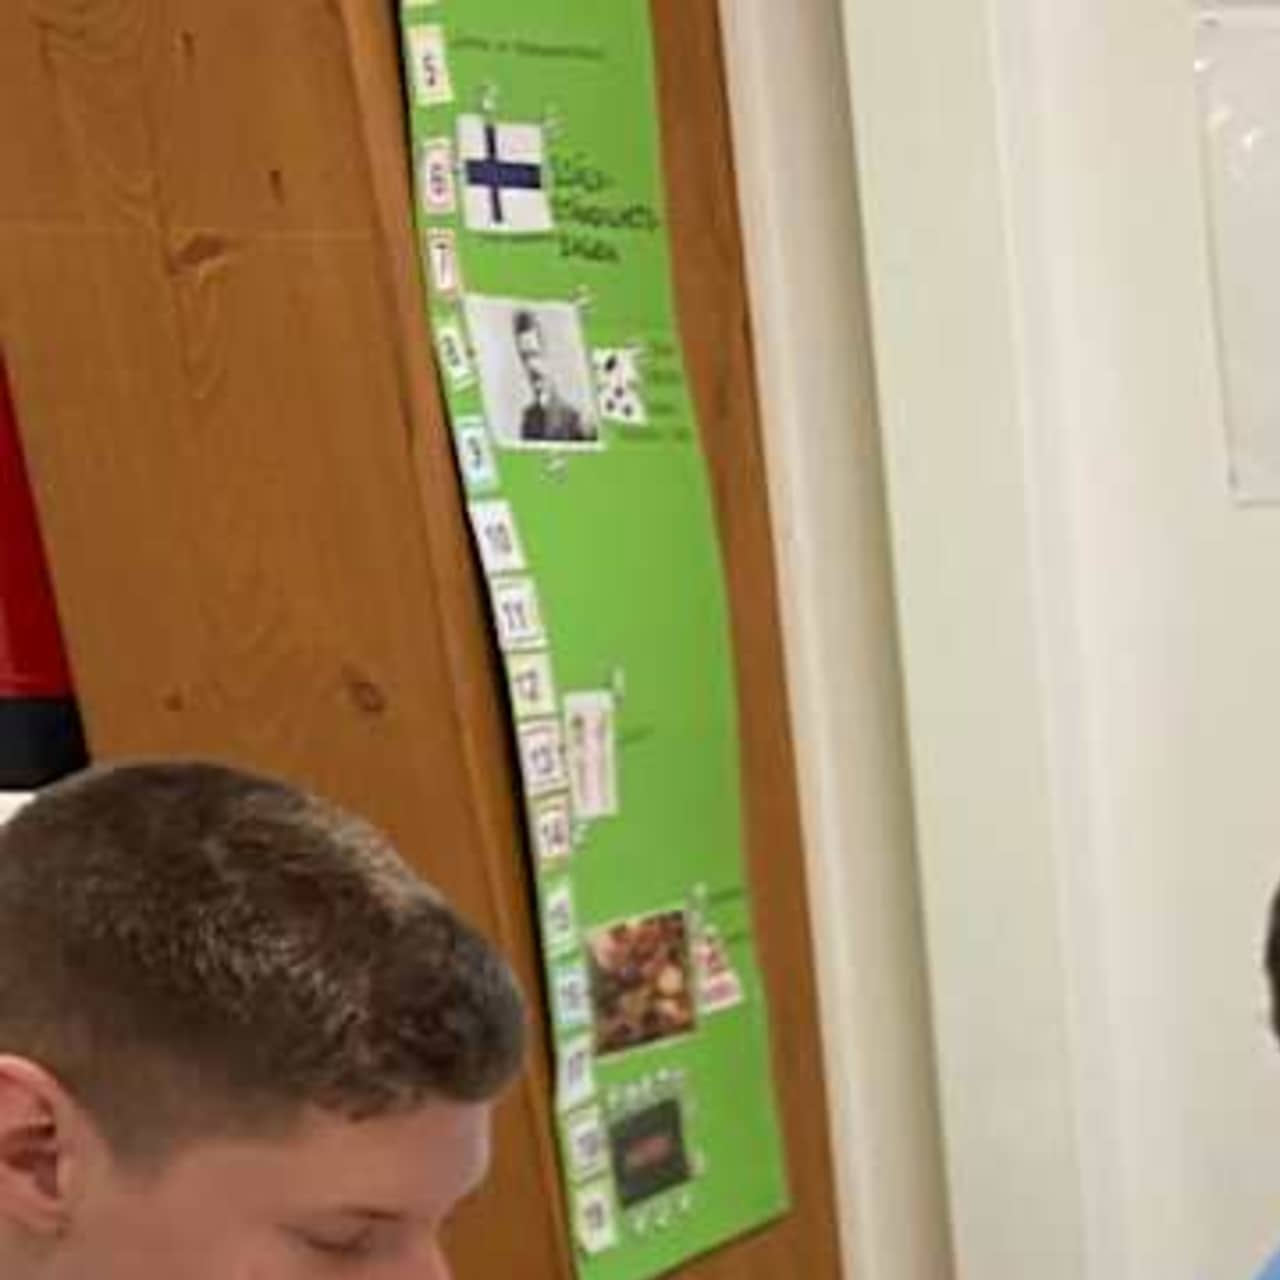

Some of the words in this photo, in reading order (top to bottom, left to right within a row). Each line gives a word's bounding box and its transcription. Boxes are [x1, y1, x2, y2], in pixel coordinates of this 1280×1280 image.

[422, 52, 435, 87] 5
[429, 162, 445, 196] 6
[434, 241, 448, 278] 7
[502, 600, 527, 631] 11
[514, 668, 538, 701] 12
[530, 743, 553, 775] 13
[542, 817, 565, 847] 14
